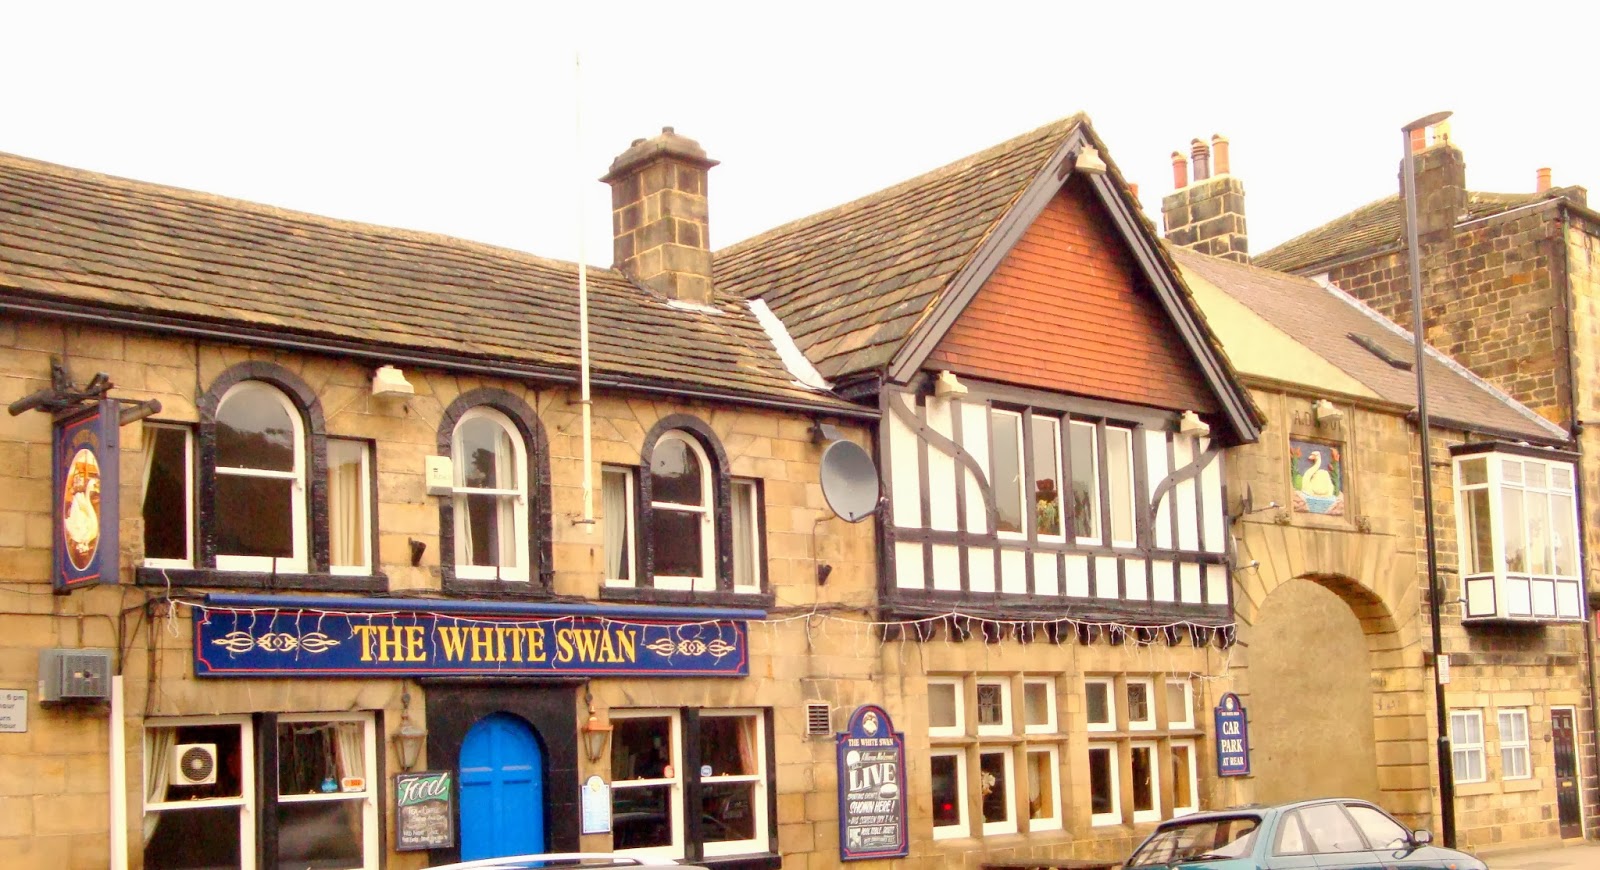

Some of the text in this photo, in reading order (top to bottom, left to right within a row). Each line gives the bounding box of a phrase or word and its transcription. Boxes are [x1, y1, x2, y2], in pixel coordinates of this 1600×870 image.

[352, 624, 637, 663] THE WHITE SWAN
[1223, 721, 1240, 735] CAR
[860, 738, 879, 746] WHITE
[1221, 739, 1243, 753] PARK
[1223, 756, 1244, 766] AT REAR
[849, 762, 896, 792] LIVE
[849, 800, 875, 814] SHOWN
